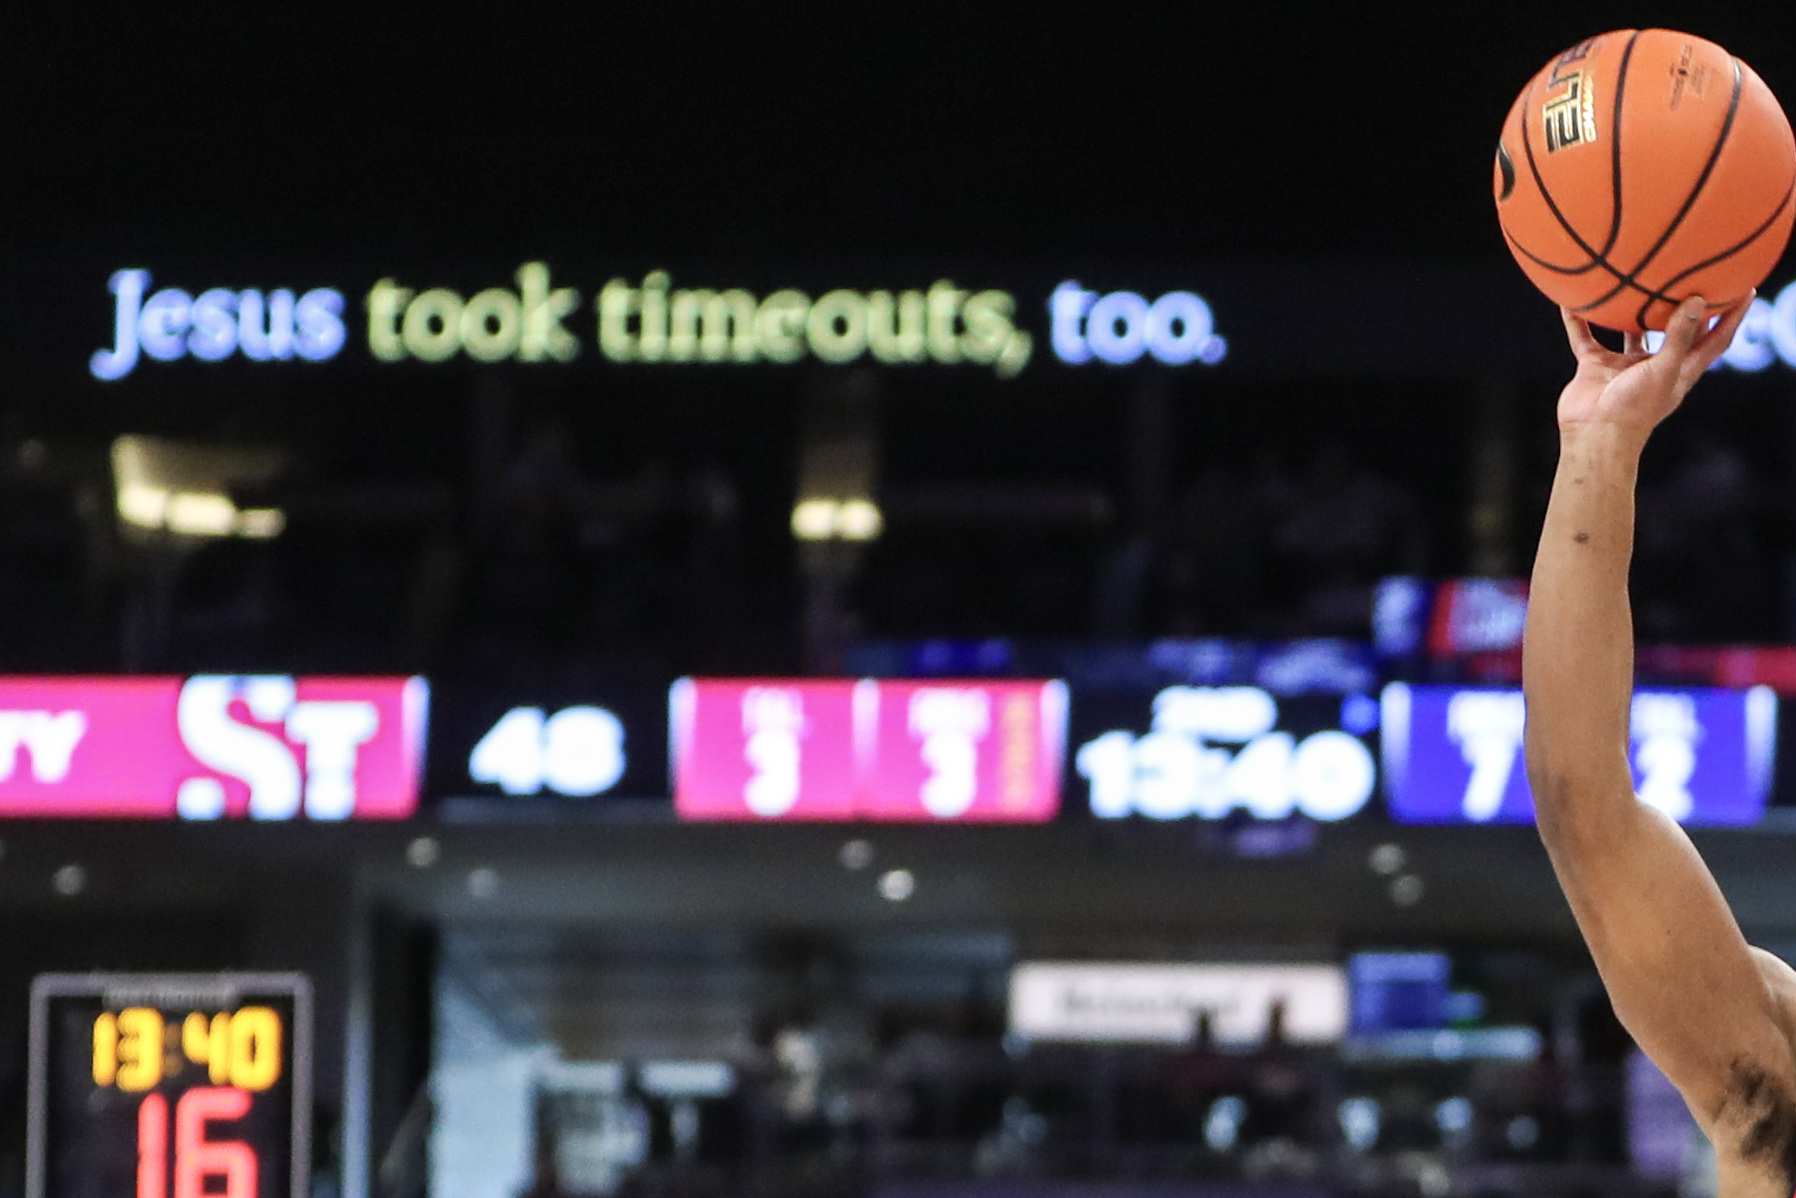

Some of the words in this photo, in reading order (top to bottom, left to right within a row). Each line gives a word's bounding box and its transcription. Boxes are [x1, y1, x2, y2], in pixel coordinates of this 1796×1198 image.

[90, 268, 346, 380] Jesus
[367, 262, 578, 362] took
[598, 269, 1032, 378] timeouts,
[1049, 280, 1227, 364] too.
[92, 1006, 283, 1092] 13:40
